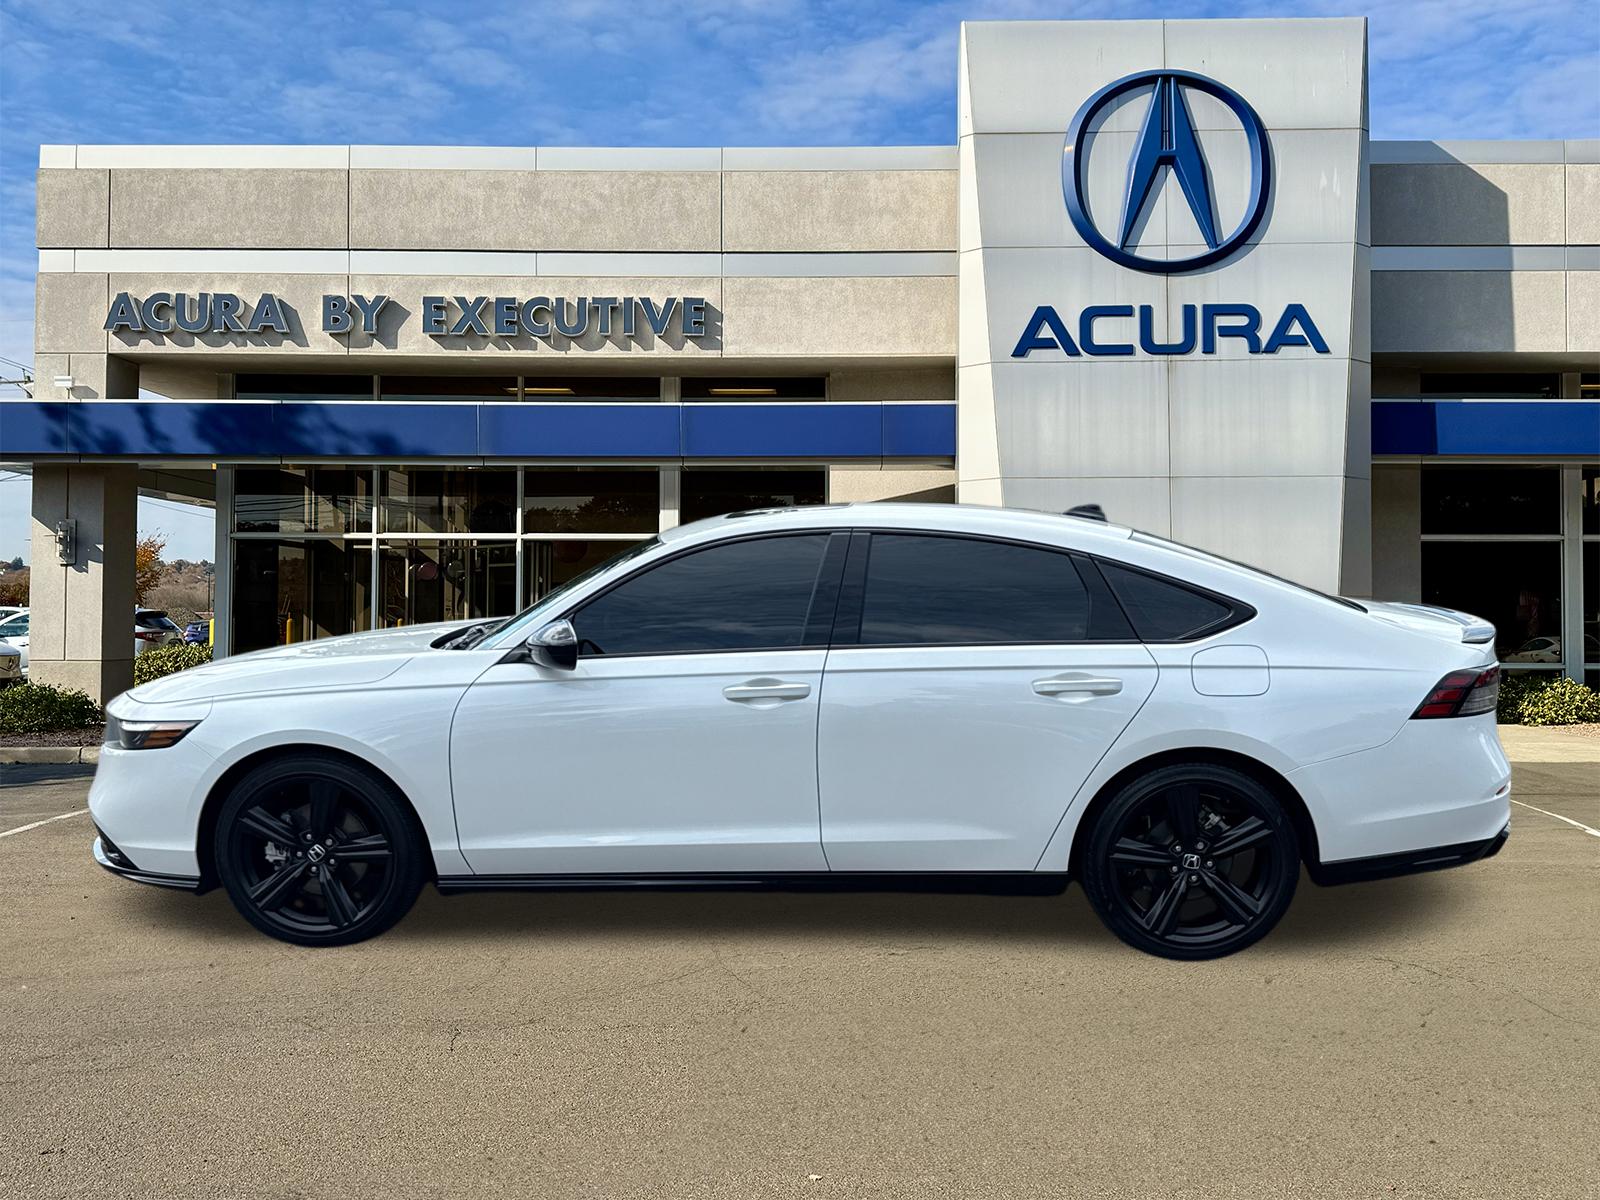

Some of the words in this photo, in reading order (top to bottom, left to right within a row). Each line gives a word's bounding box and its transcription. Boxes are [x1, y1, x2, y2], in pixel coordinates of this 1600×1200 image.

[103, 291, 290, 334] ACURA
[321, 294, 391, 334] BY
[421, 296, 706, 337] EXECUTIVE
[1010, 303, 1332, 358] ACURA
